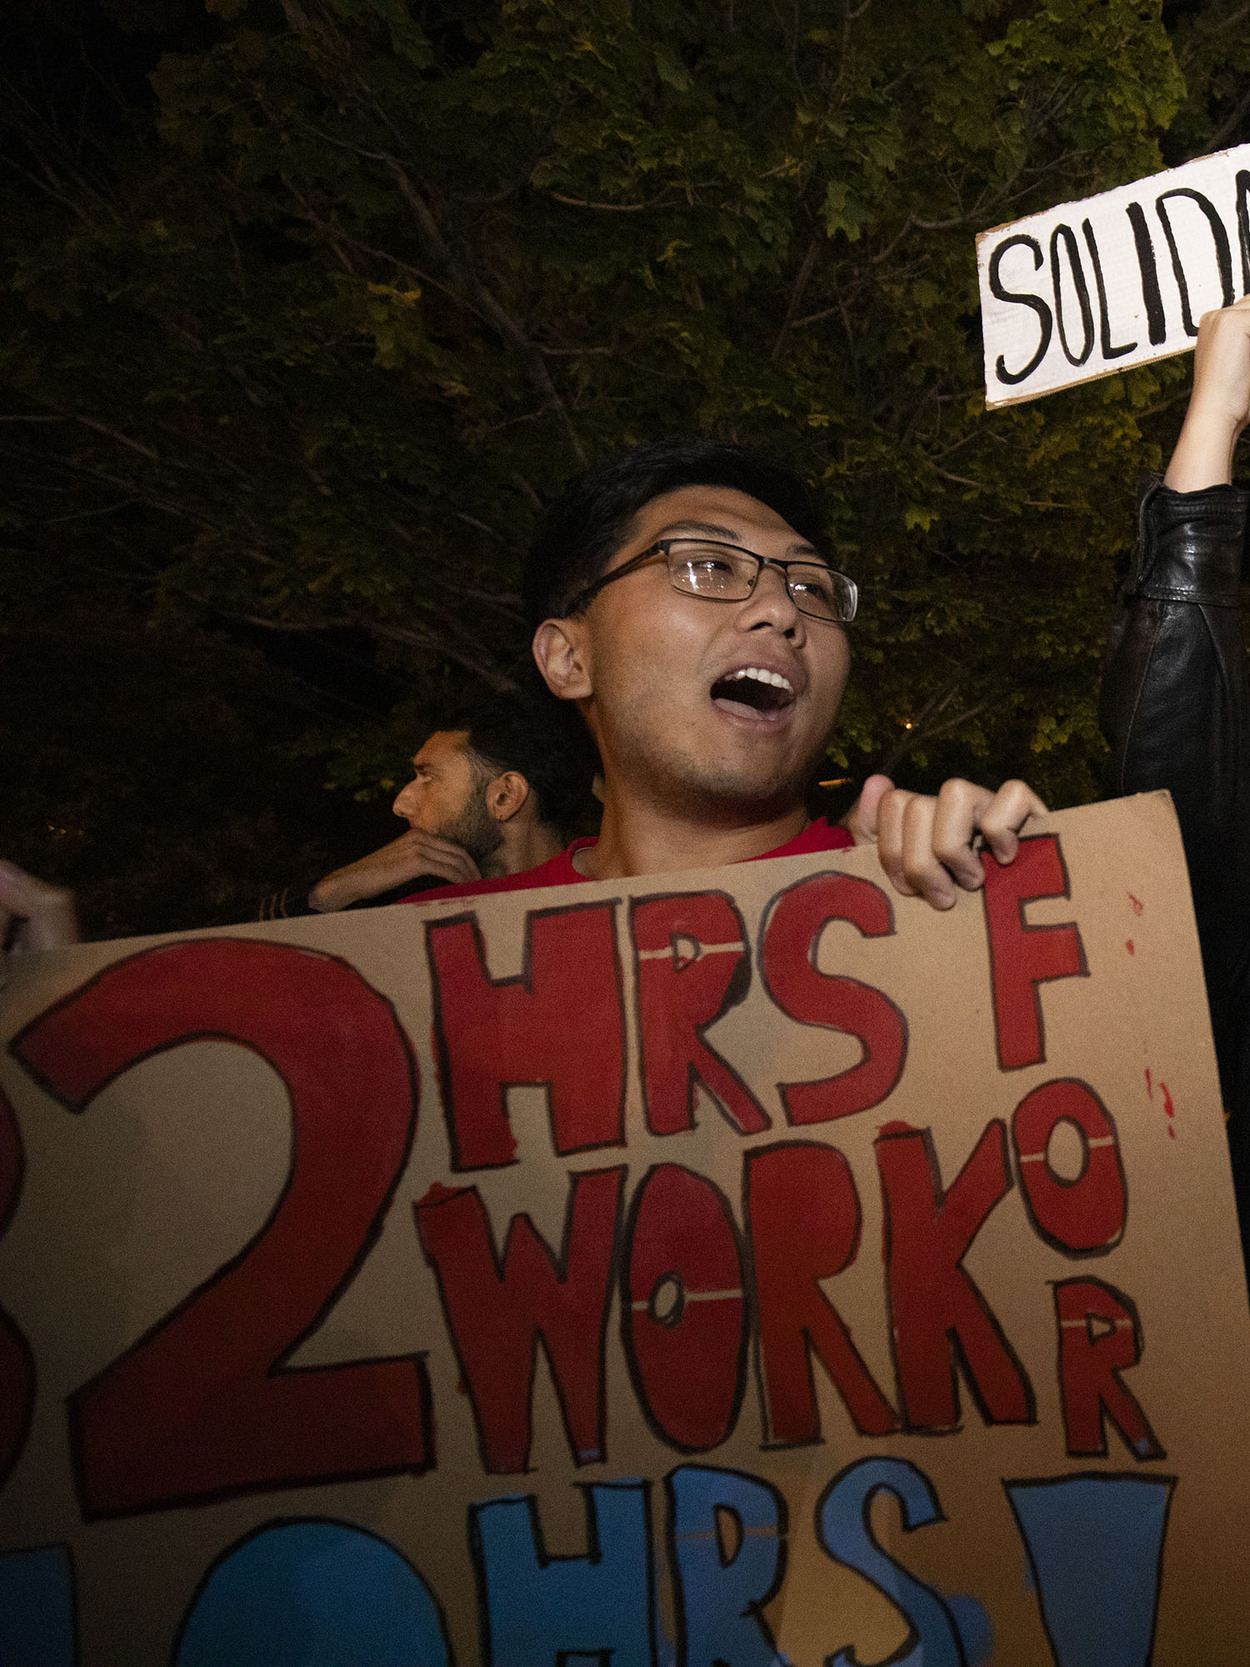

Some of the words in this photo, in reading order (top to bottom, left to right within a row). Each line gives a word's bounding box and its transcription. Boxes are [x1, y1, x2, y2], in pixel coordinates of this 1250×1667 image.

[0, 937, 437, 1522] 2
[424, 869, 910, 1173] HRS
[413, 1120, 1039, 1478] WORK
